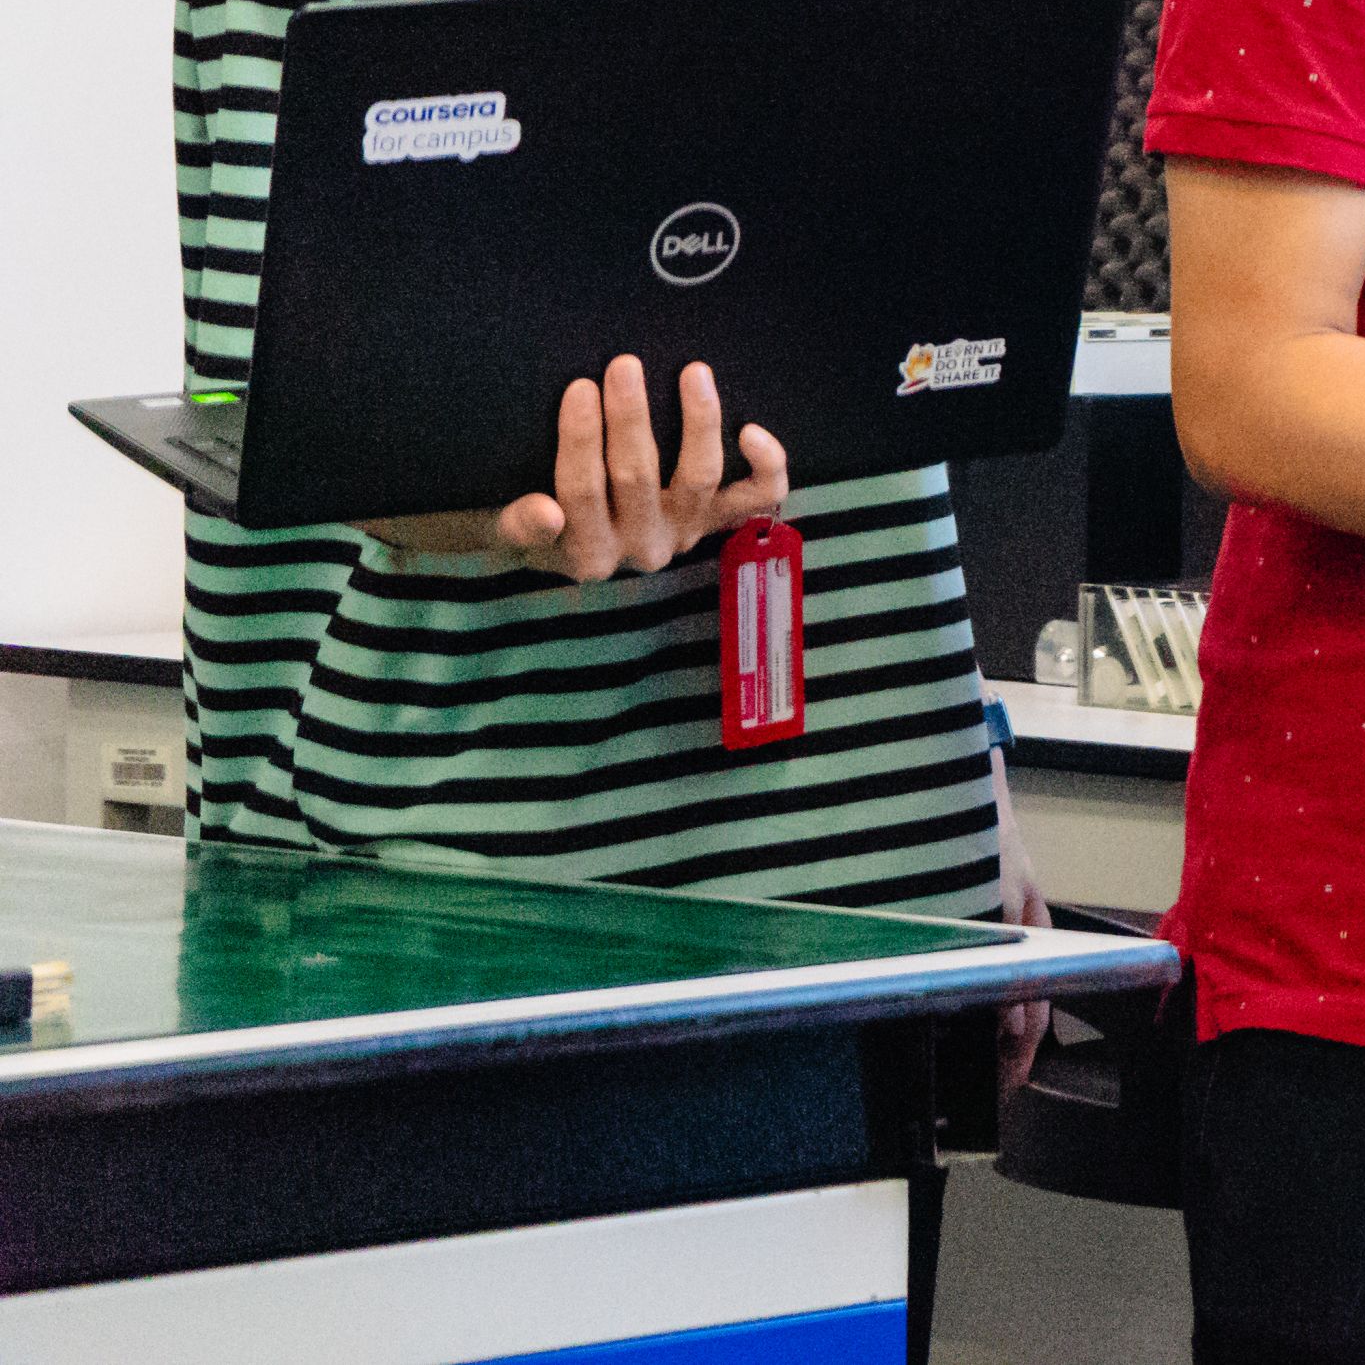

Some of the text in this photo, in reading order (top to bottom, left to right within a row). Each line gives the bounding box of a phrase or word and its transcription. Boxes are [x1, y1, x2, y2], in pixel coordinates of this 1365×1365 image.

[375, 98, 498, 125] coursera
[371, 125, 513, 152] for campus
[662, 232, 729, 257] DELL
[933, 369, 981, 384] SHARE
